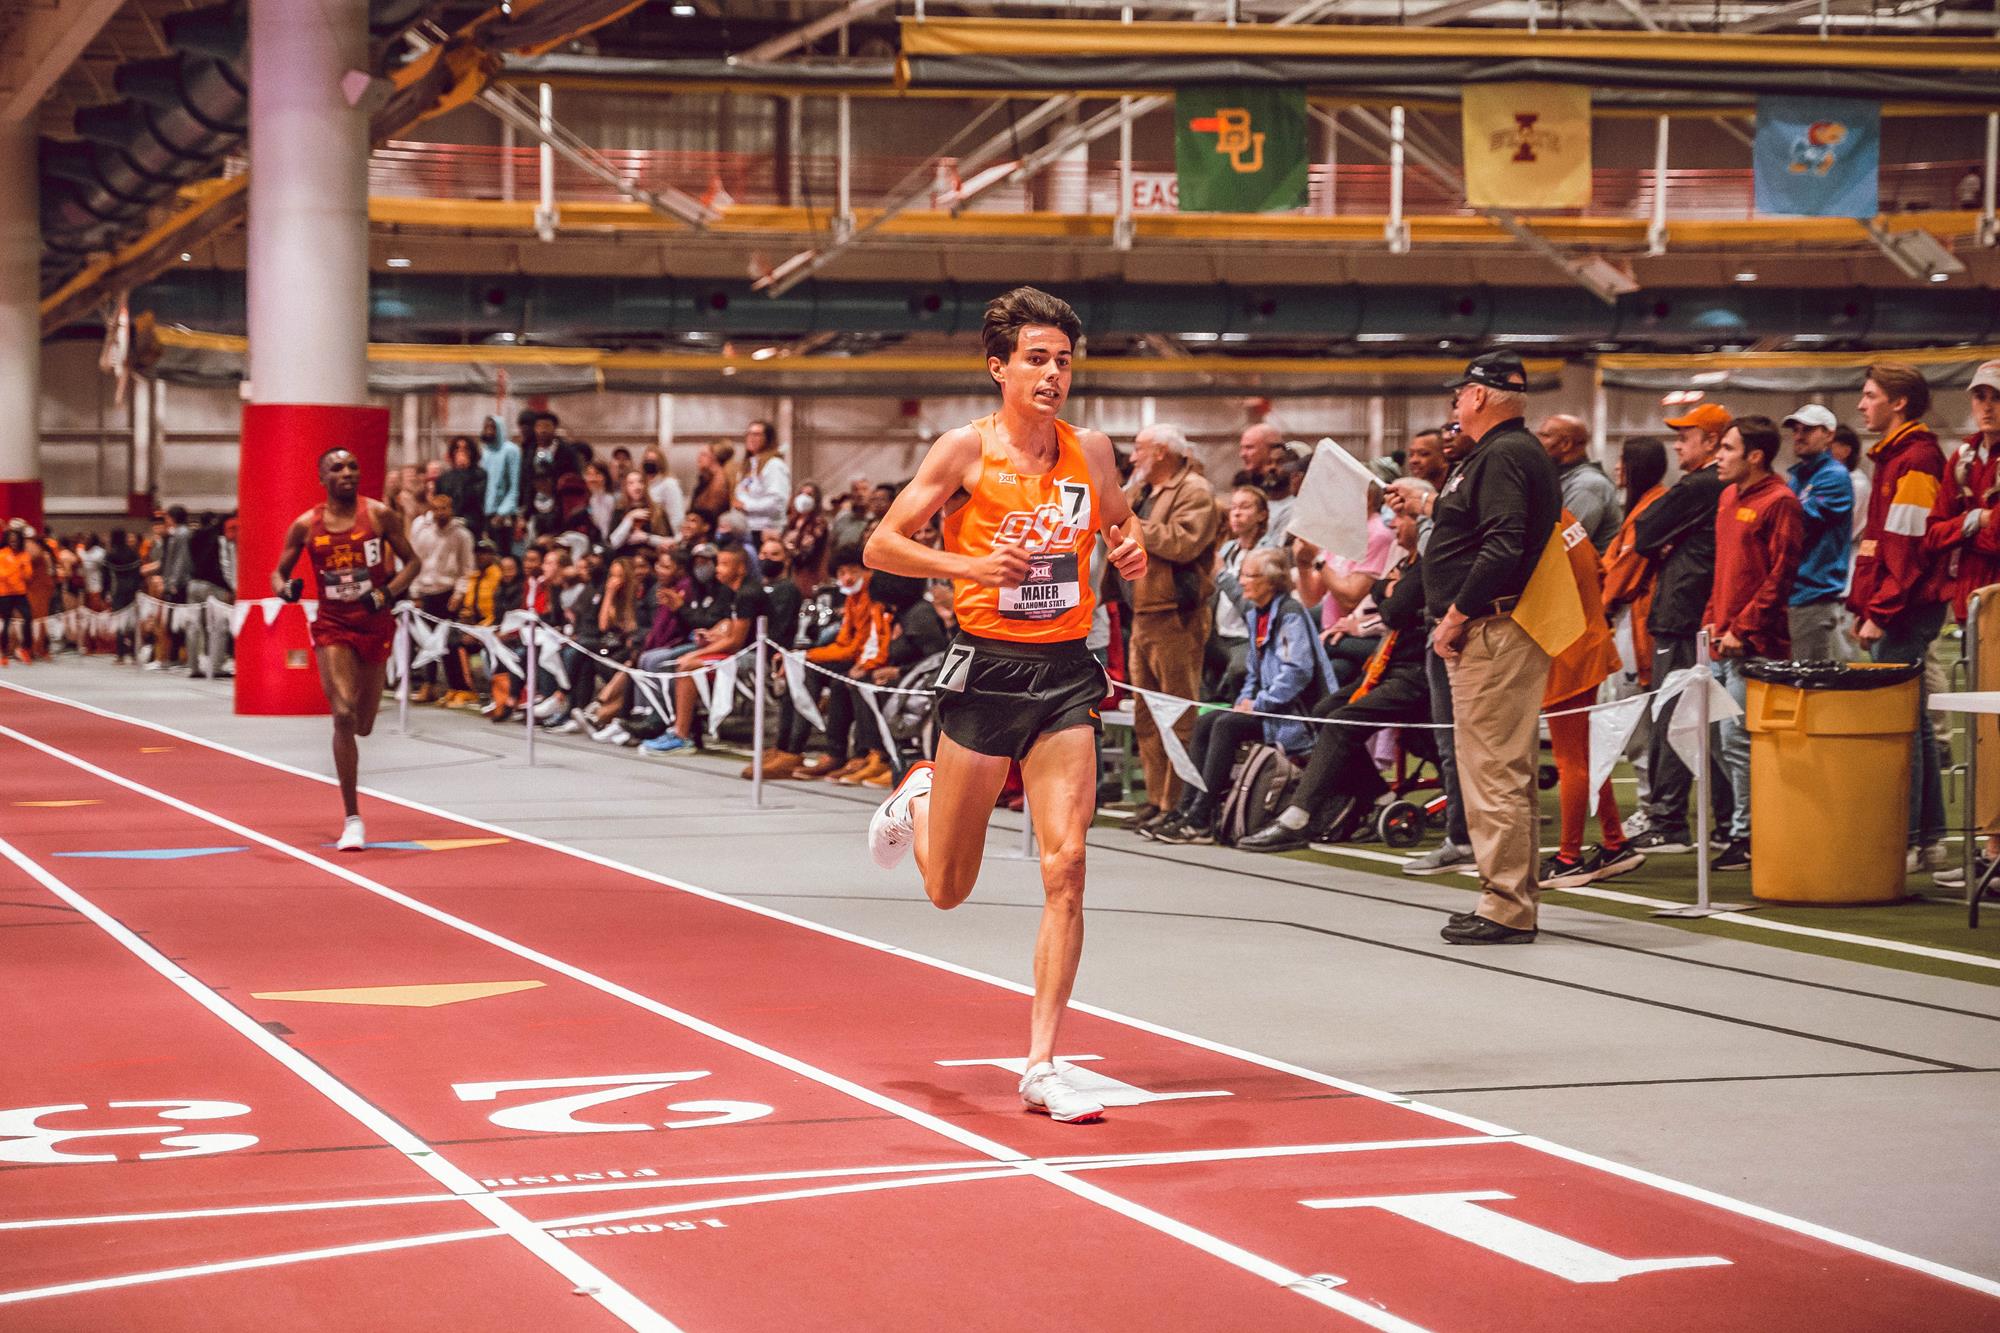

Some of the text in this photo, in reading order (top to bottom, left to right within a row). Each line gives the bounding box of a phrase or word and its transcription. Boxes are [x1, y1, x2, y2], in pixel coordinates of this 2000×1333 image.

[1064, 486, 1085, 524] 7
[1014, 600, 1066, 610] OKLAHOMA STATE
[1021, 585, 1059, 601] MAIER
[941, 648, 971, 685] 7
[452, 1070, 774, 1133] 2
[0, 1099, 260, 1163] 3
[480, 1168, 659, 1187] FINISH
[546, 1218, 728, 1239] 1500M
[1298, 1190, 1734, 1283] 1
